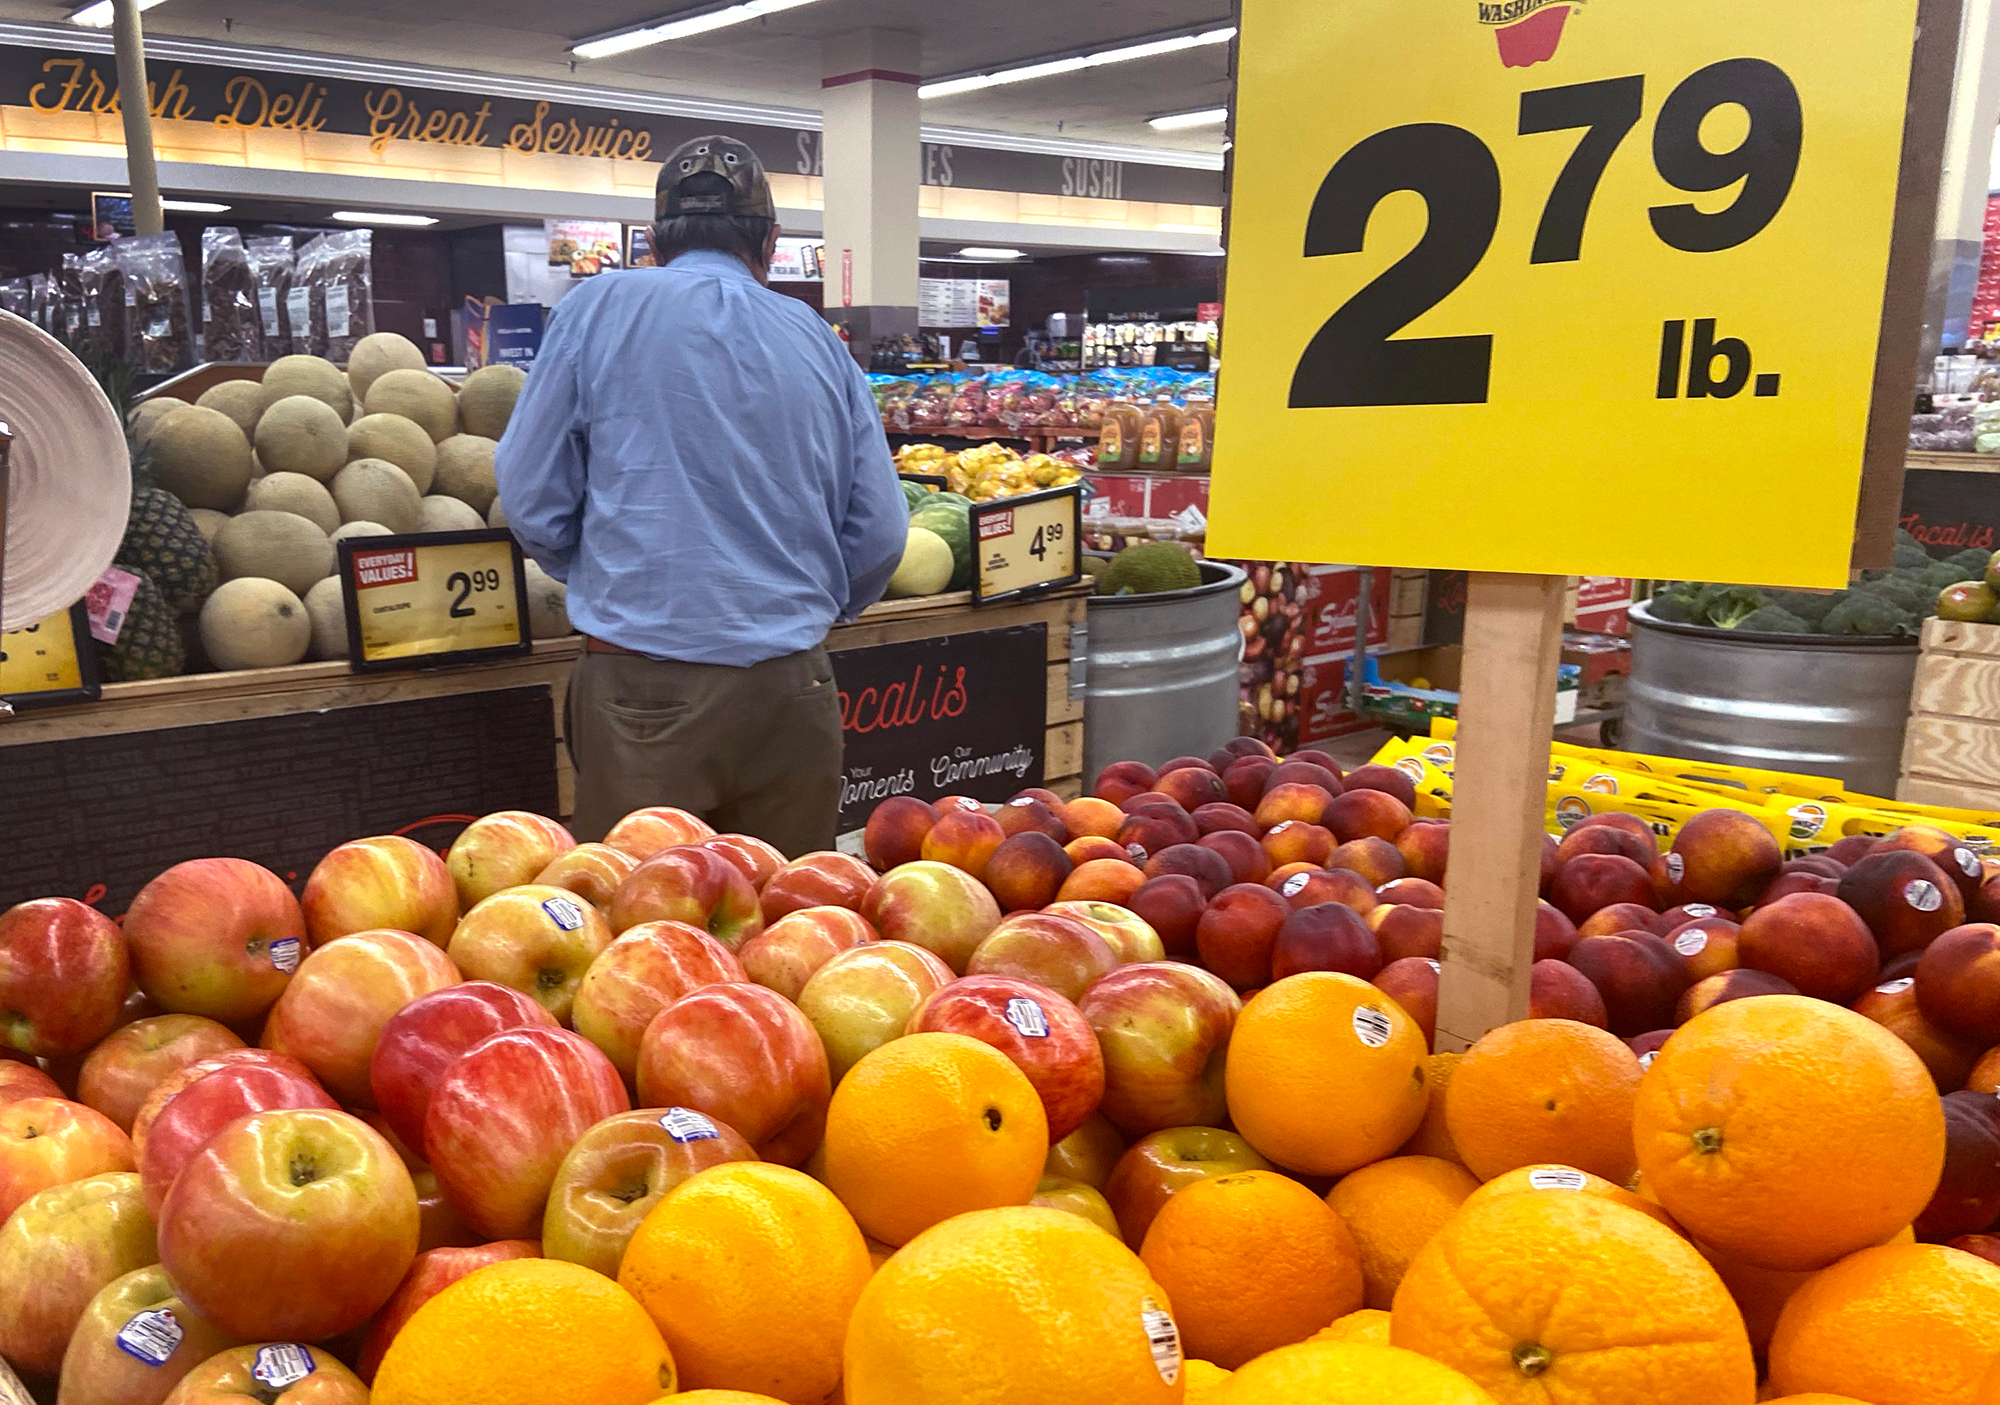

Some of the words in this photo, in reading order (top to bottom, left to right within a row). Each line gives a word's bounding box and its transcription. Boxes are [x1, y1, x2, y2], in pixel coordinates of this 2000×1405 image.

[214, 75, 327, 131] Deli
[364, 88, 494, 155] Great
[502, 100, 652, 161] Service
[1061, 157, 1124, 199] SUSHI
[1655, 317, 1782, 400] lb.
[358, 552, 405, 569] EVERYDAY
[838, 664, 926, 733] ocal
[930, 664, 967, 720] is
[850, 766, 873, 778] Your
[930, 744, 1034, 788] Community
[954, 746, 973, 759] Our
